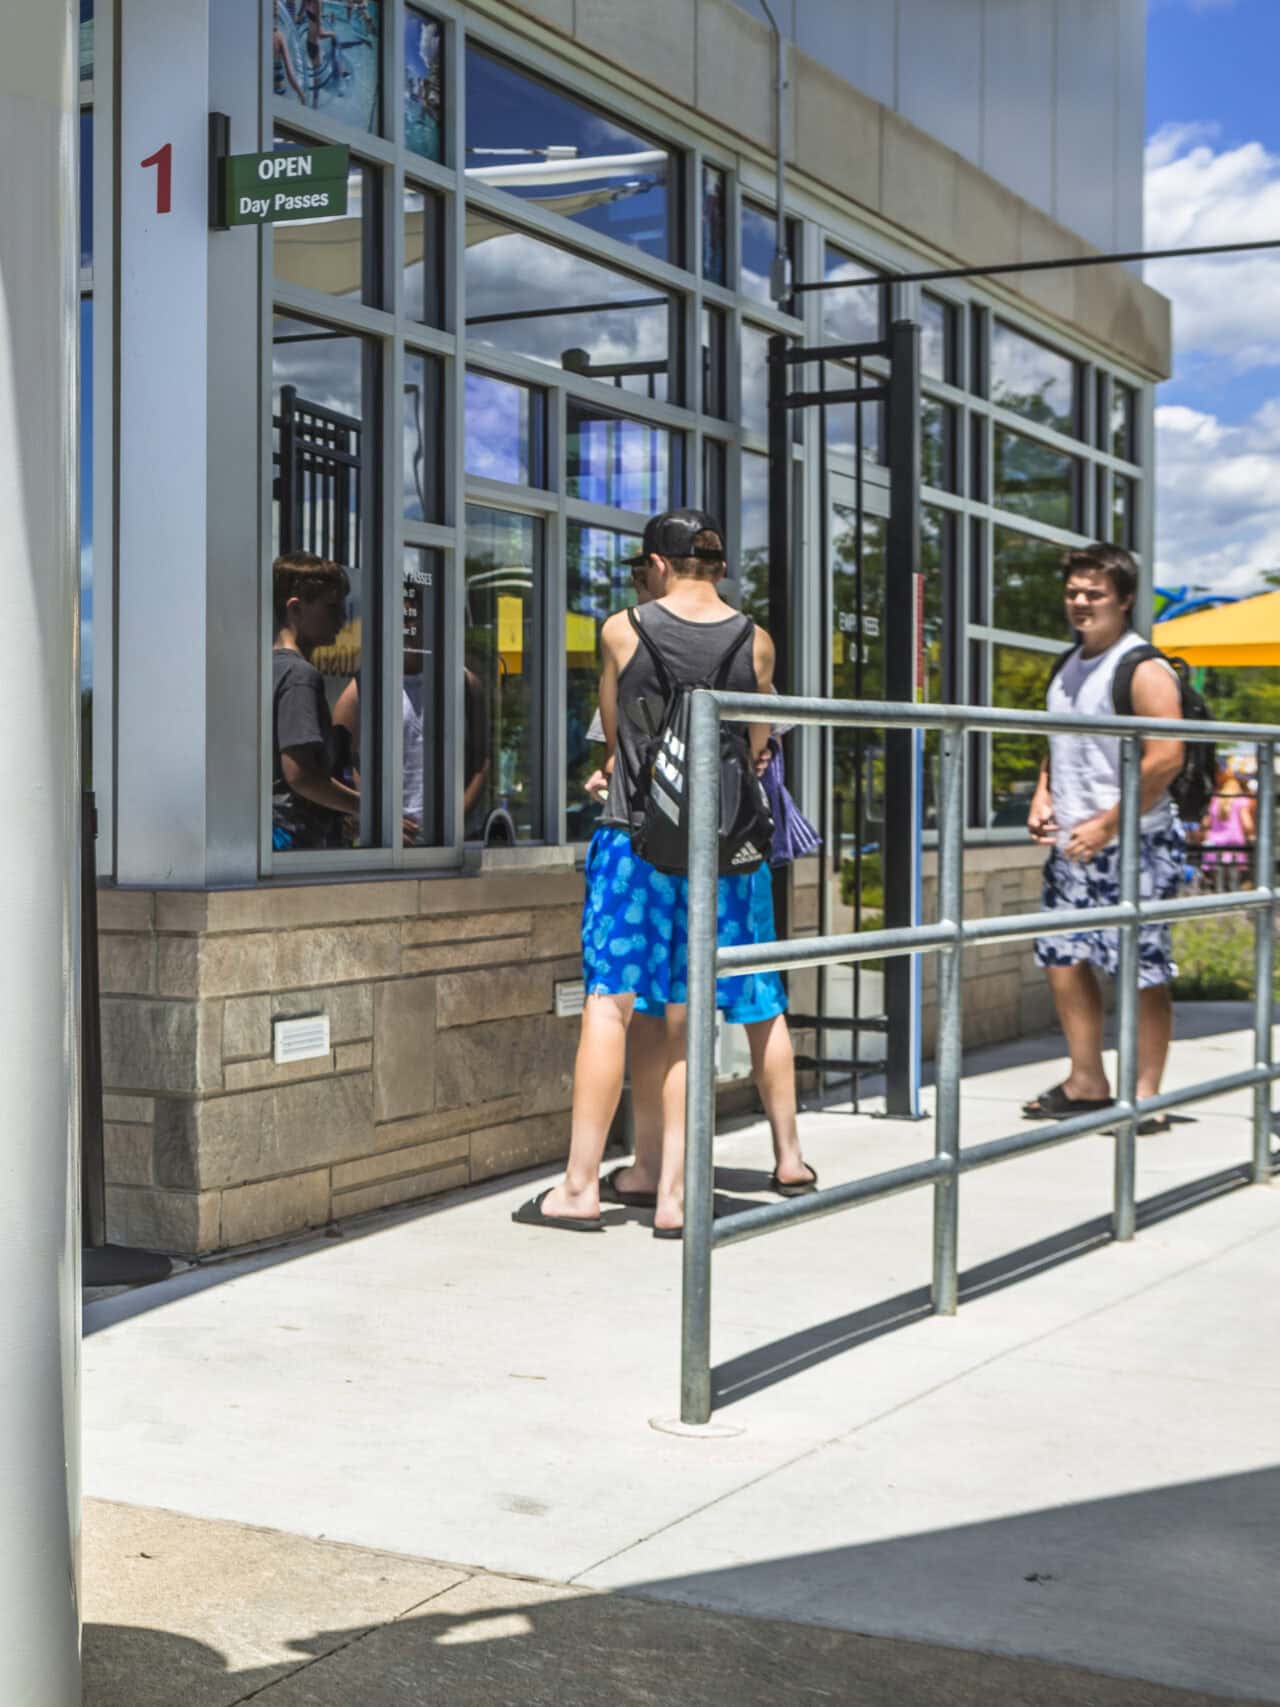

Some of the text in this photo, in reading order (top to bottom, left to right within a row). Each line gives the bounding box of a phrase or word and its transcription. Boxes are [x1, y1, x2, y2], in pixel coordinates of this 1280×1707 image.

[140, 143, 172, 214] 1
[258, 155, 313, 180] OPEN
[240, 192, 329, 217] Day Passes
